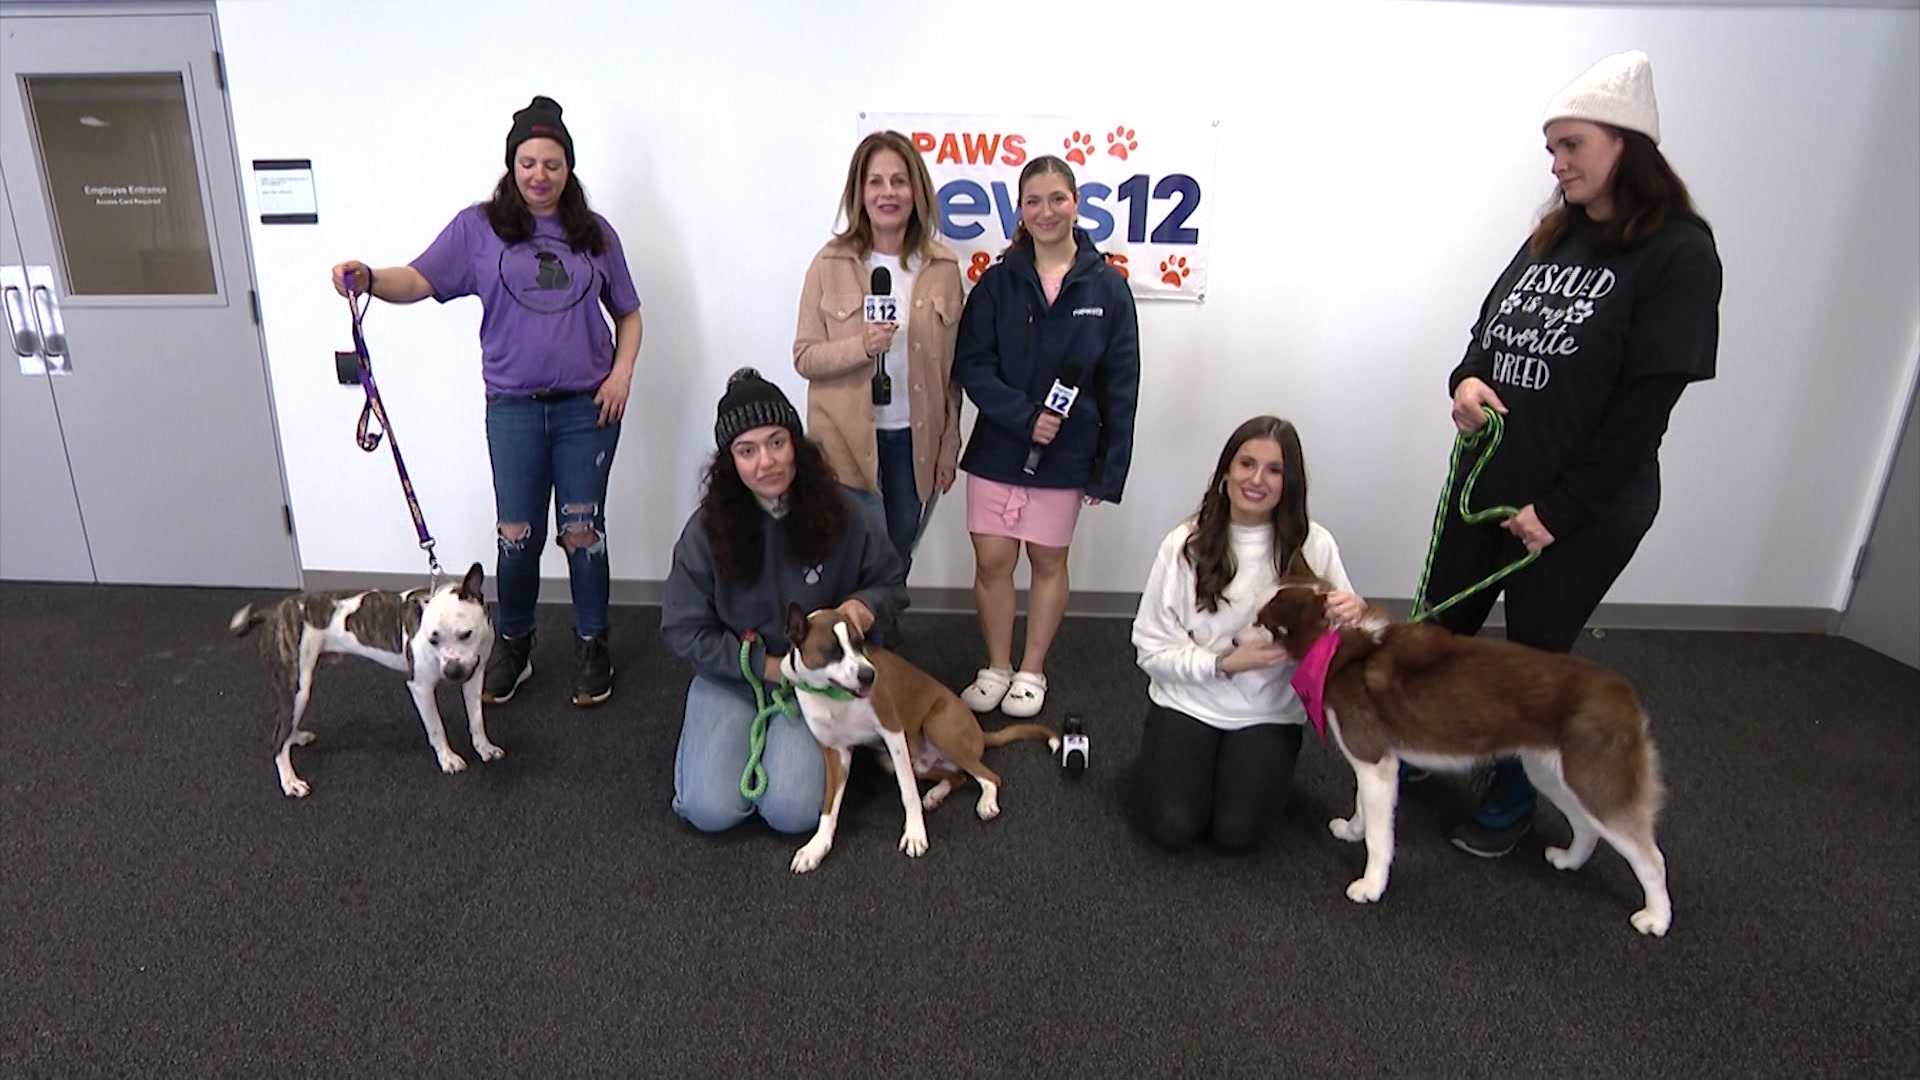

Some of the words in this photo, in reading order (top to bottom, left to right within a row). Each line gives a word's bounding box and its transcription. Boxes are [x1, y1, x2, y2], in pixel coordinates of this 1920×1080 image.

[911, 132, 1028, 167] PAWS
[83, 185, 127, 197] Employee
[128, 185, 168, 195] Entrance
[95, 198, 118, 206] Access
[118, 198, 134, 206] Card
[134, 198, 162, 206] Required
[935, 173, 1202, 245] es12
[966, 251, 992, 283] &
[1512, 263, 1617, 299] RESCUED
[879, 303, 897, 321] 12
[1521, 295, 1543, 314] is
[1538, 307, 1567, 330] my
[1481, 314, 1581, 356] favorite
[1492, 351, 1551, 391] BREED
[1050, 392, 1071, 413] 12
